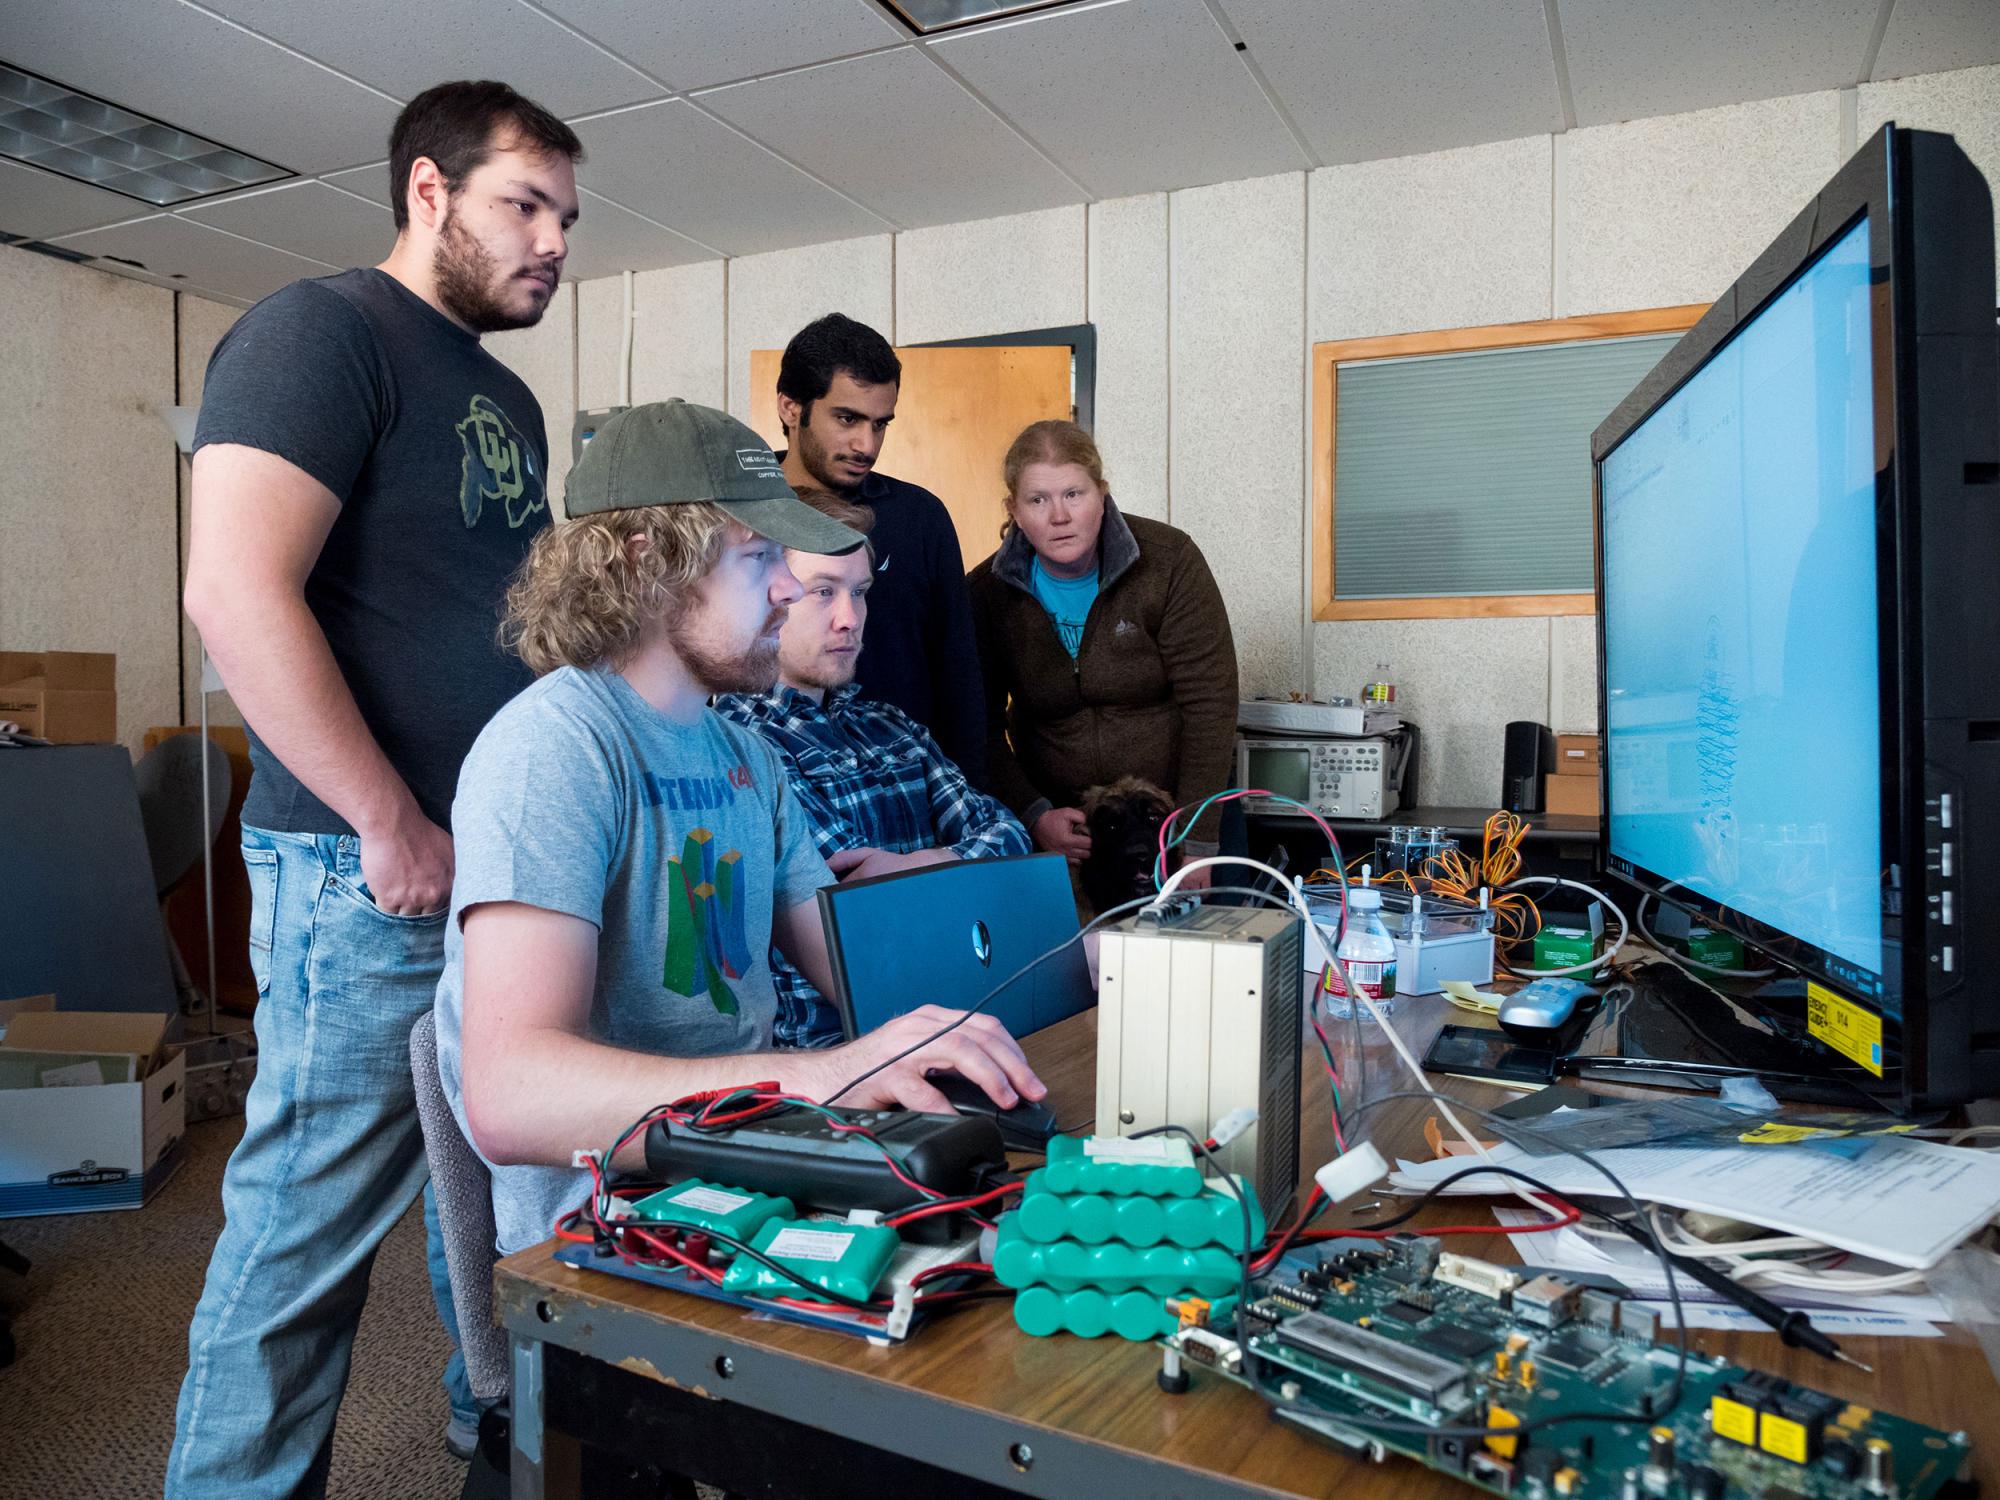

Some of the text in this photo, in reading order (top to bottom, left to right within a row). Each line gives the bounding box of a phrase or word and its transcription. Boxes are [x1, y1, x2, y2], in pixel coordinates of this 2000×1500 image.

[475, 411, 524, 499] CU
[53, 1172, 123, 1185] BANKERS BOX
